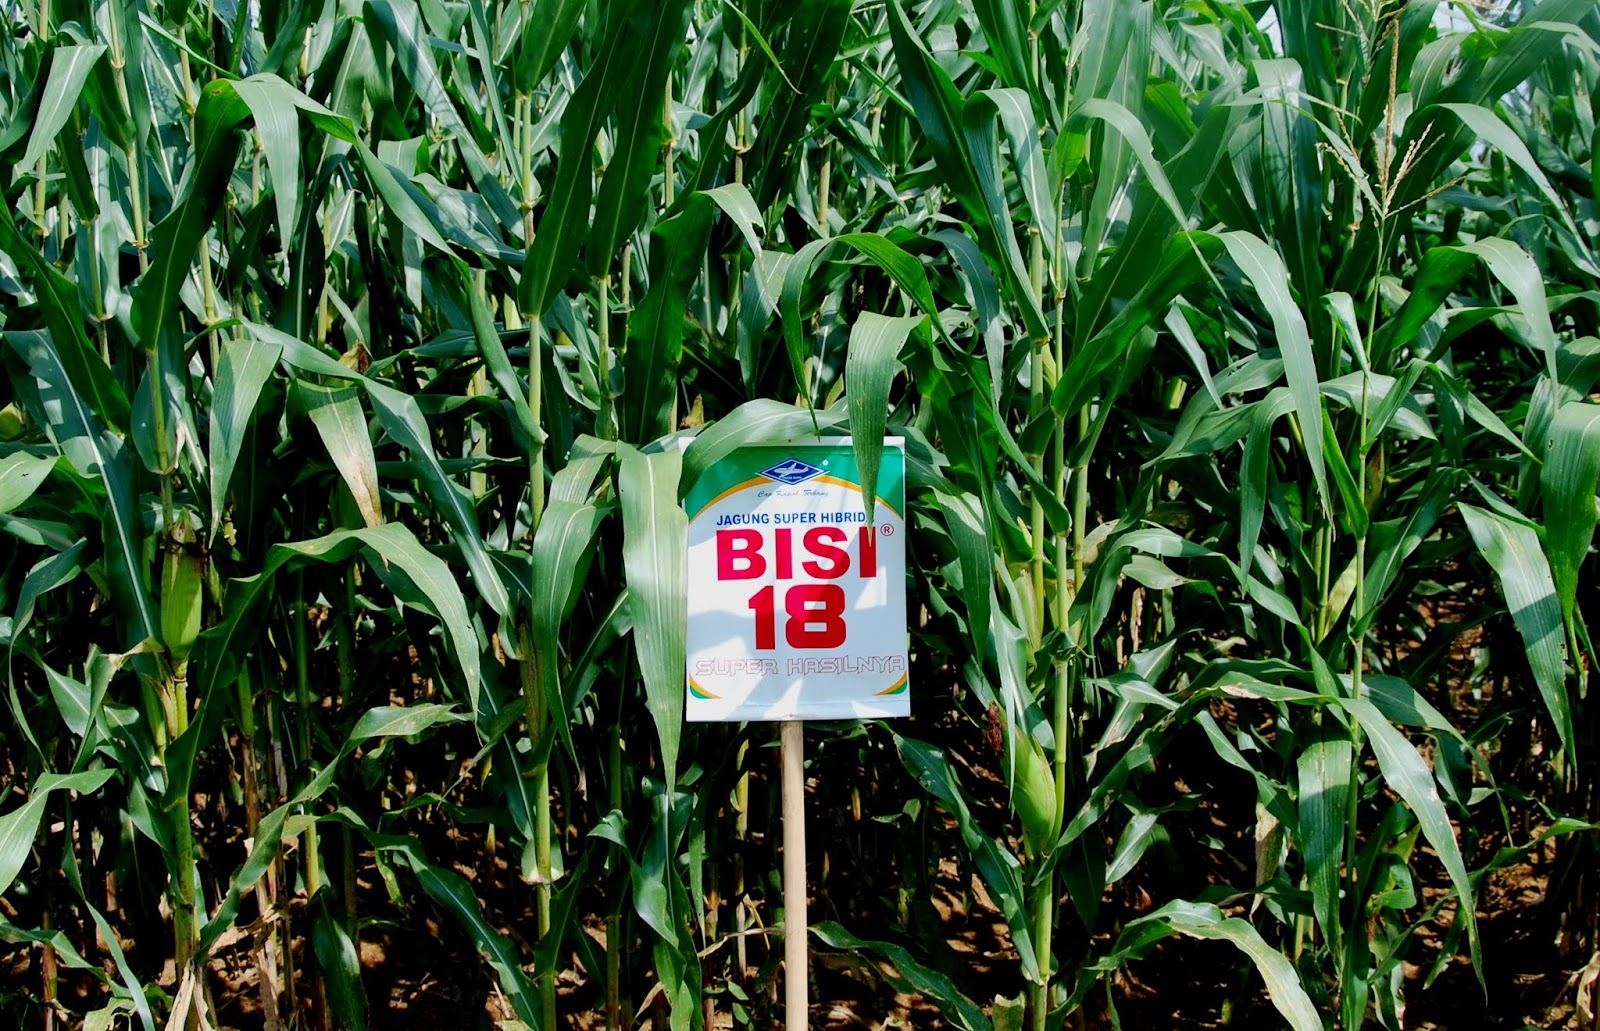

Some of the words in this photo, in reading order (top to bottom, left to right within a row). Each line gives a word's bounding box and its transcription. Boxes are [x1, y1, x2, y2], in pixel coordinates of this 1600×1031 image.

[716, 513, 770, 526] JAGUNG
[774, 513, 816, 524] SUPER
[821, 512, 875, 523] HIBRID
[716, 526, 877, 581] BISI
[748, 584, 847, 650] 18
[695, 658, 778, 677] SUPER
[787, 655, 905, 677] HASILNYA
